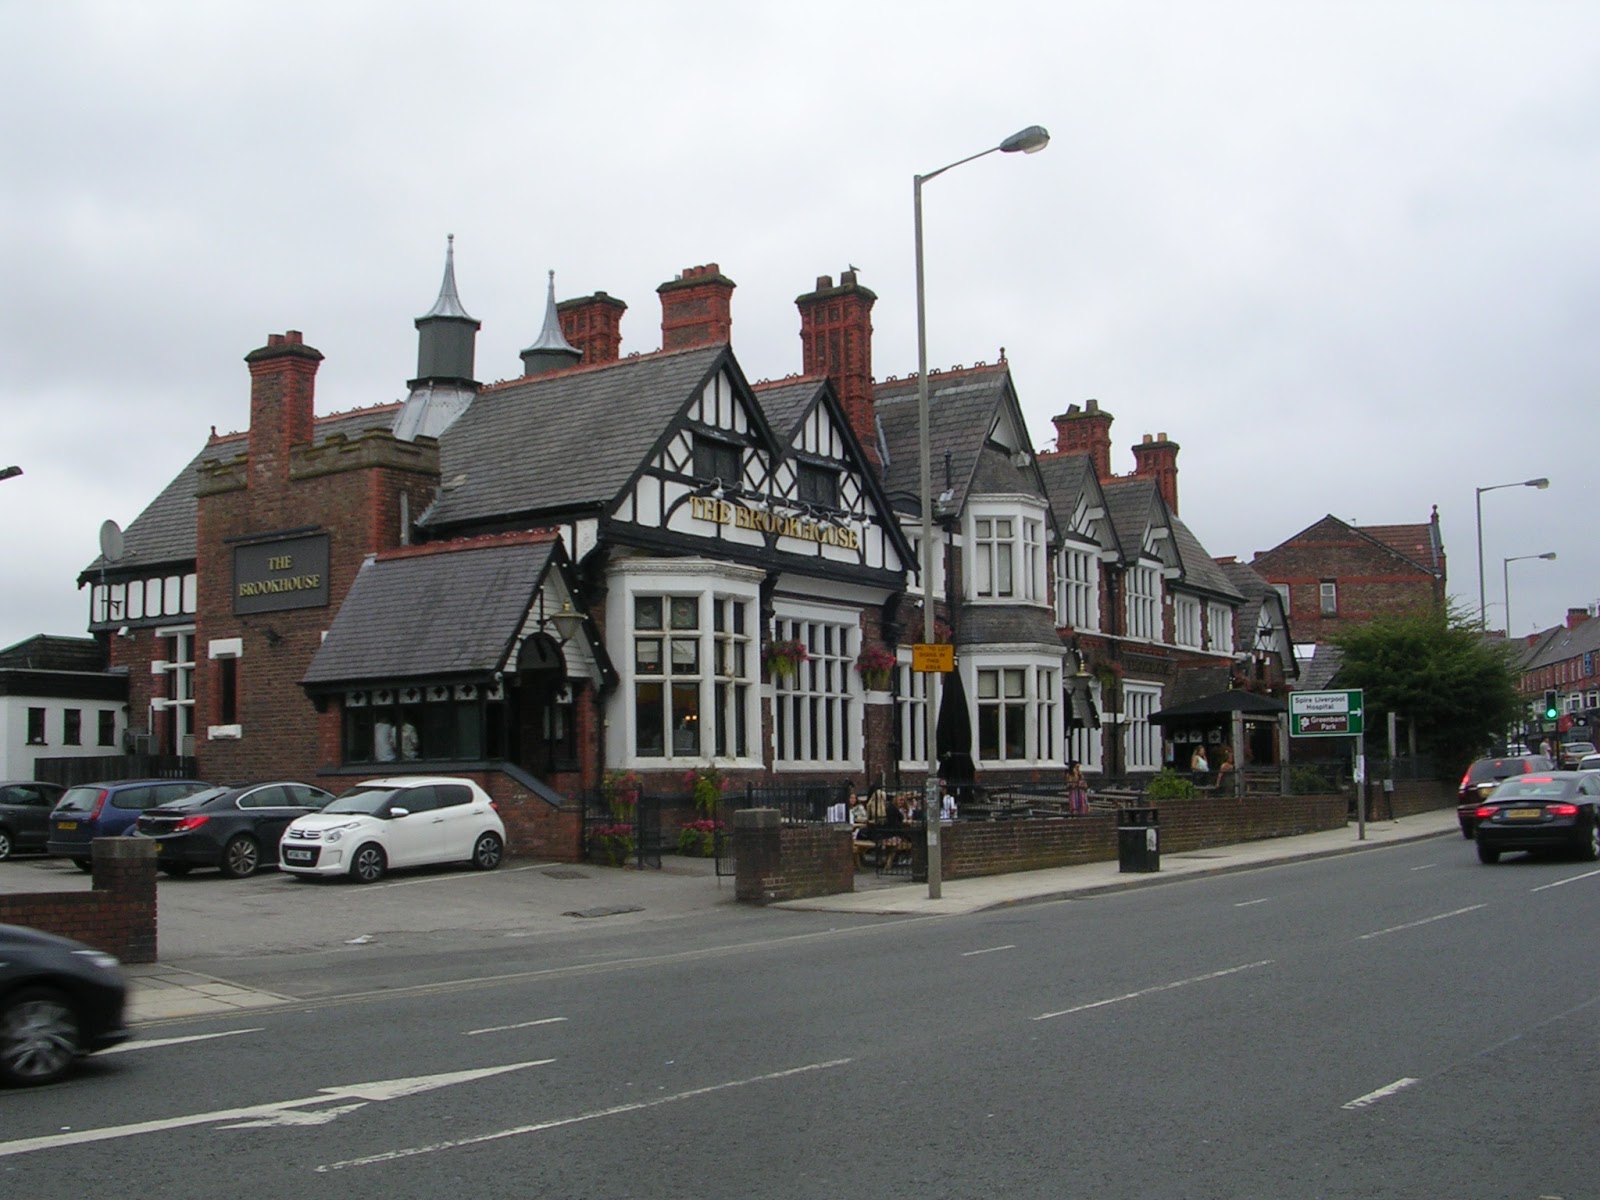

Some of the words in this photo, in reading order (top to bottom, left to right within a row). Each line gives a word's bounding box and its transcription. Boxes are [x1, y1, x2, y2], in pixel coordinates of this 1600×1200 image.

[690, 496, 731, 525] THE
[735, 505, 859, 550] BROOKHOUSE
[268, 555, 293, 571] THE
[239, 574, 320, 597] BROOKHOUSE
